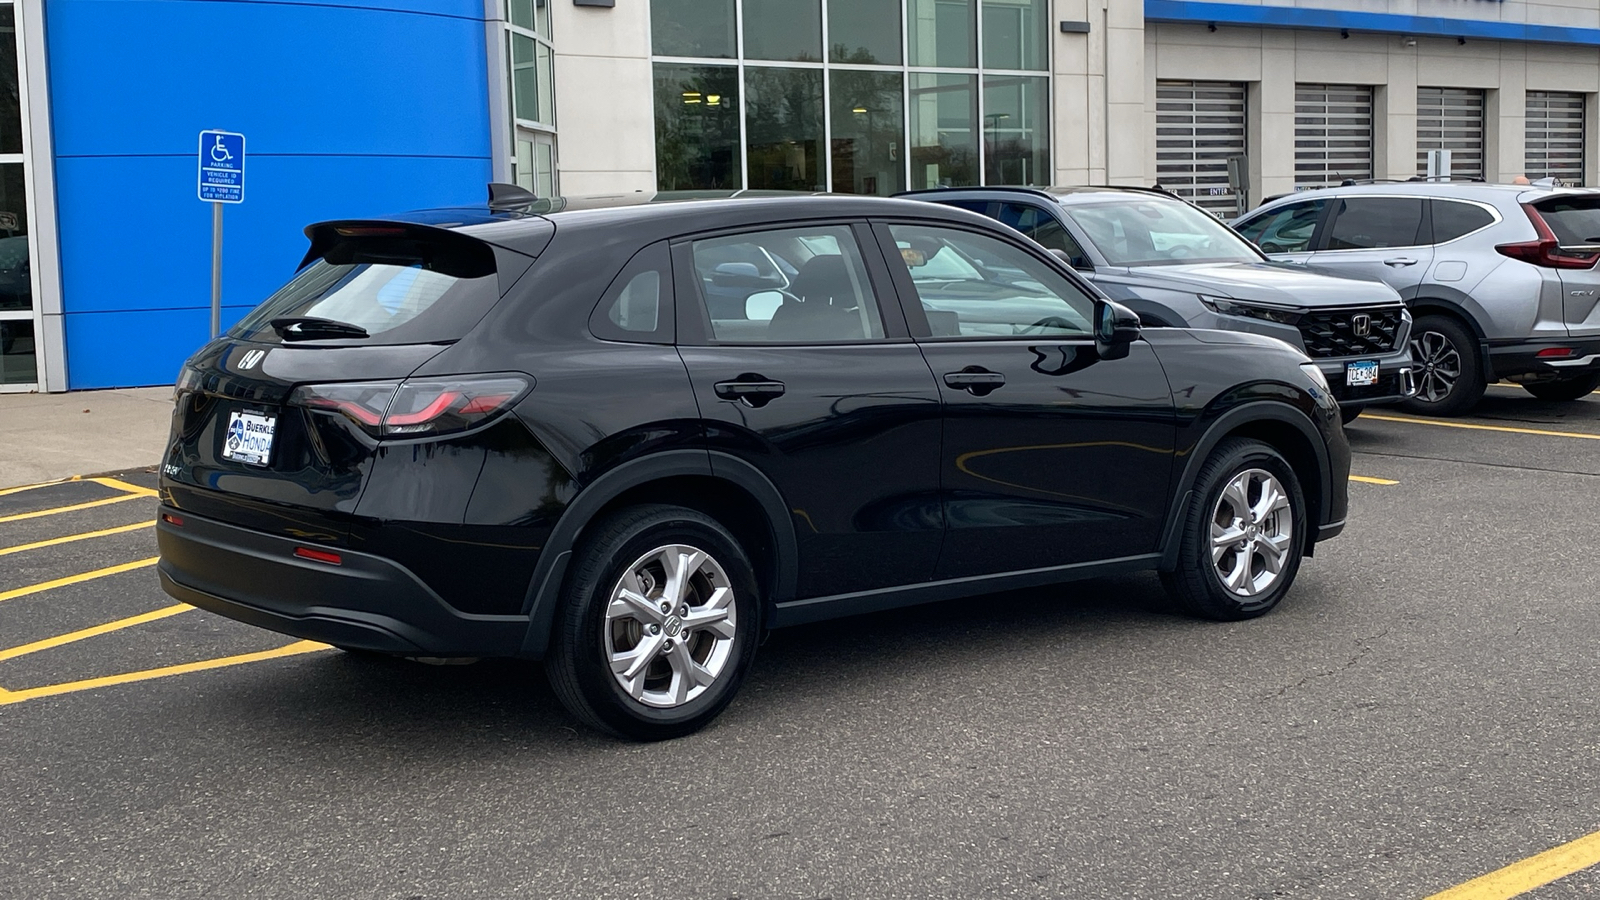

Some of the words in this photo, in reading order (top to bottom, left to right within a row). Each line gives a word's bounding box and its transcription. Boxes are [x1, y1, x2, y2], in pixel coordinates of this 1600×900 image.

[206, 170, 229, 178] VEHICLE
[208, 177, 235, 185] REQUIRED
[1210, 187, 1228, 196] ENTER
[246, 420, 275, 434] BUERKLE
[243, 432, 272, 452] HONDA
